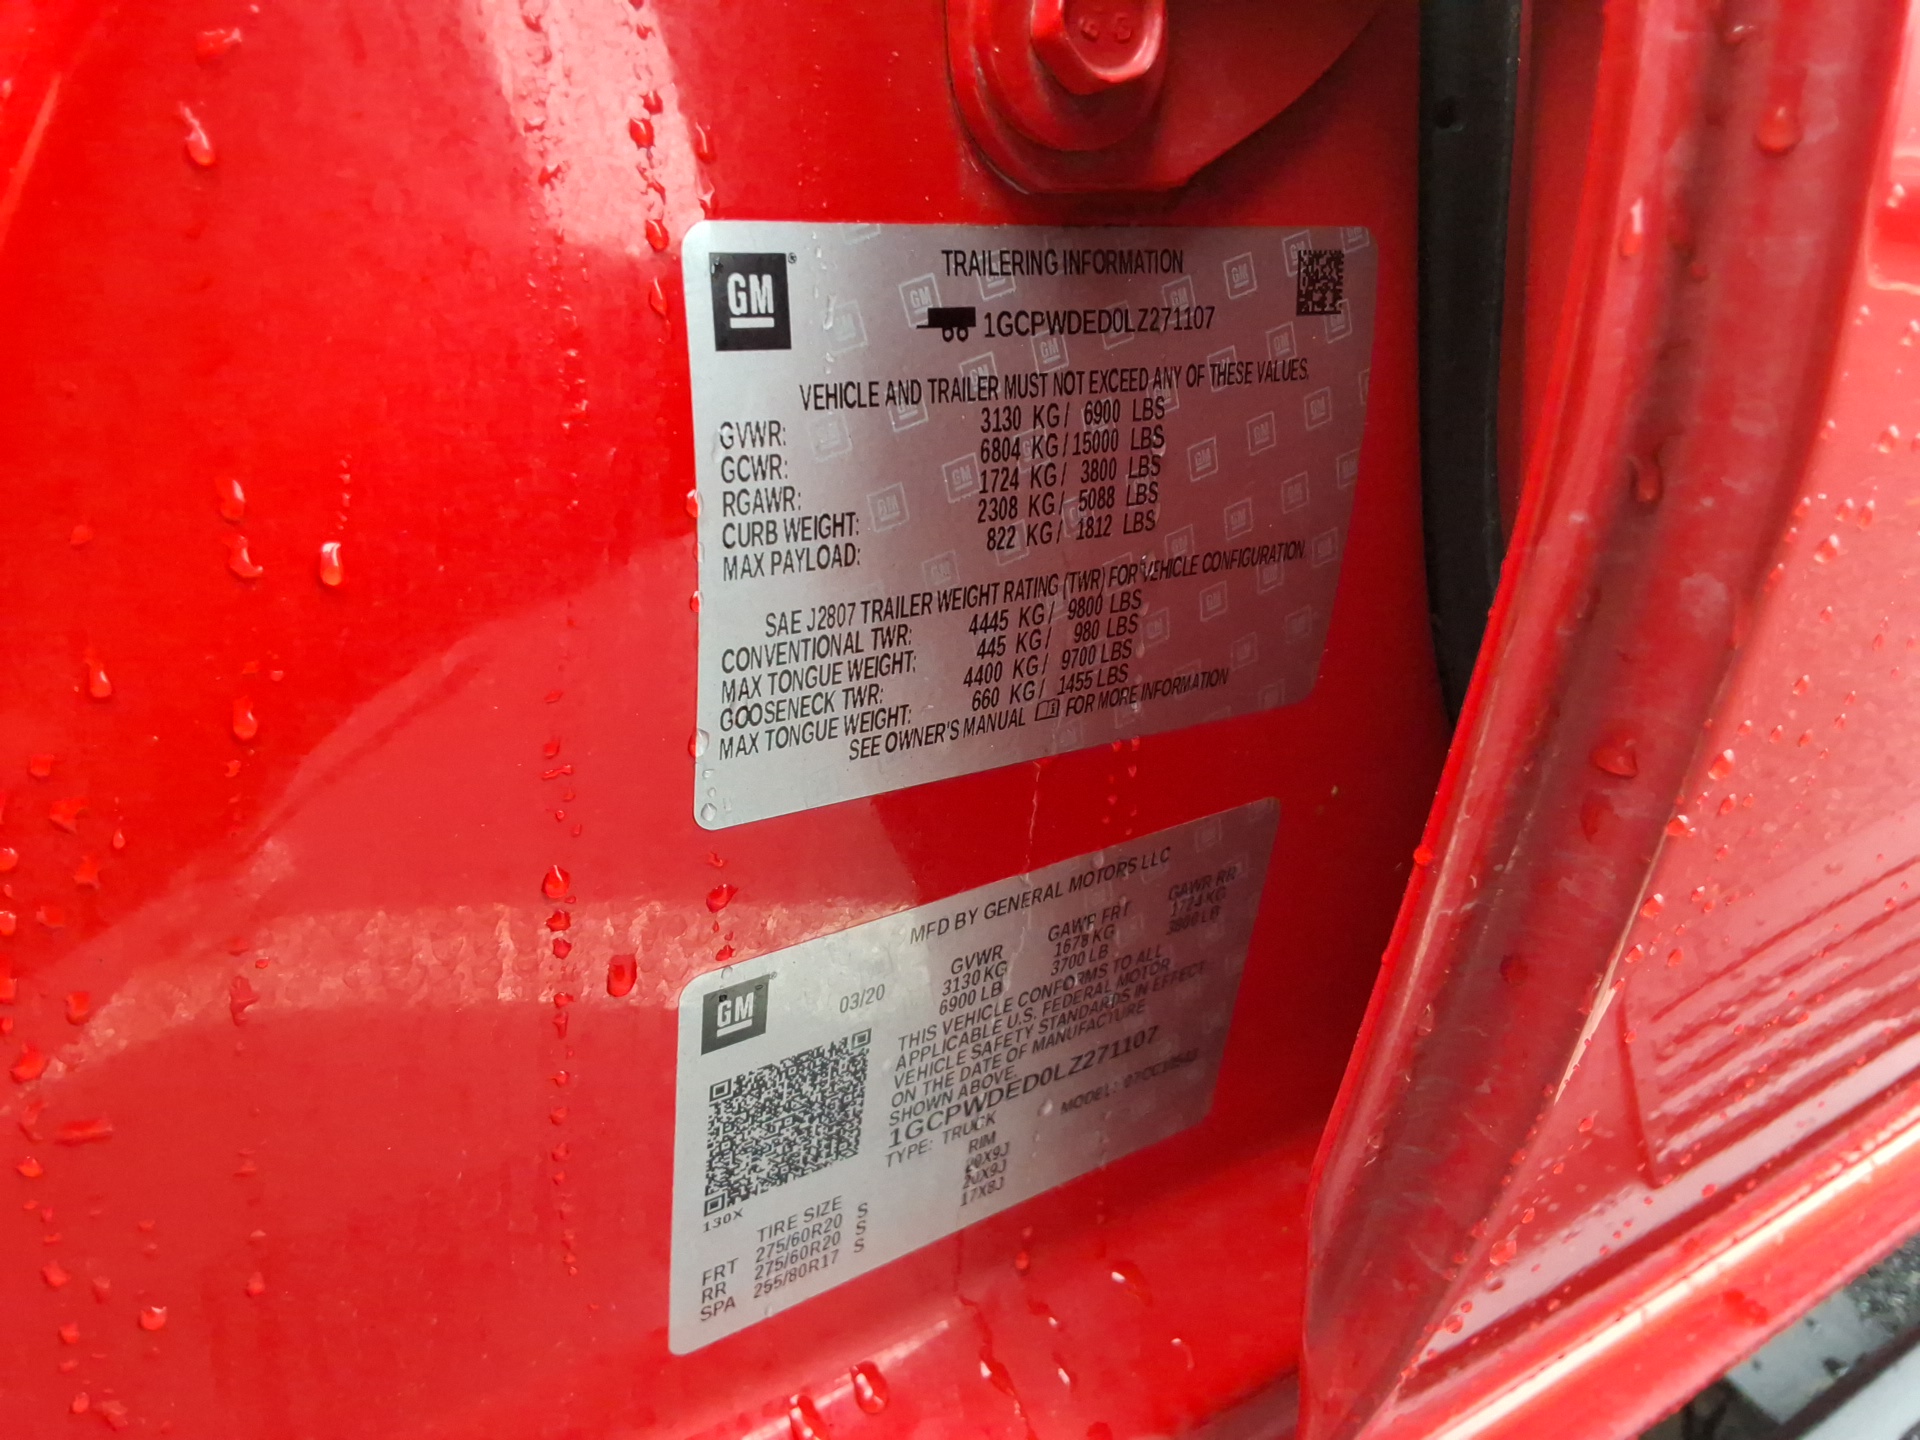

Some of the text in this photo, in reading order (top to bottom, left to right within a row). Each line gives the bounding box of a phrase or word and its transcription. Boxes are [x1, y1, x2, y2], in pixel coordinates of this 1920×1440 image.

[941, 248, 1184, 277] TRAILERING INFORMATION
[727, 272, 775, 316] GM
[799, 357, 1310, 411] VEHICLE AND TRAILER MUST NOT EXCEED ANY OF THESE VALUES.
[980, 407, 1021, 433] 3130
[1084, 399, 1121, 426] 6900
[1132, 395, 1166, 422] LBS
[719, 420, 787, 450] GVWR:
[980, 436, 1021, 464] 6804
[1072, 428, 1119, 456] 15000
[1130, 424, 1165, 452] LBS
[721, 453, 788, 484] GCWR:
[979, 466, 1020, 494] 1724
[1080, 458, 1117, 485] 3800
[1128, 453, 1162, 479] LBS
[722, 486, 801, 518] RGAWR:
[977, 496, 1018, 524] 2308
[1078, 486, 1115, 513] 5088
[1126, 482, 1159, 507] LBS
[721, 511, 860, 549] CURB WEIGHT:
[986, 524, 1016, 551] 822
[1075, 515, 1113, 541] 1812
[1123, 510, 1156, 534] LBS
[723, 542, 860, 582] MAX PAYLOAD:
[765, 609, 802, 639] SAE
[806, 603, 856, 632] J2807
[860, 592, 933, 624] TRAILER
[936, 581, 1001, 612] WEIGHT
[1003, 573, 1059, 603] RATING
[1062, 568, 1106, 598] (TWR)
[1107, 563, 1139, 588] FOR
[1141, 554, 1200, 583] VEHICLE
[968, 611, 1009, 636] 4445
[1067, 594, 1102, 620] 9800
[1109, 588, 1142, 614] LBS
[721, 623, 913, 674] CONVENTIONAL TWR:
[976, 635, 1006, 660] 445
[1073, 620, 1100, 643] 980
[1106, 613, 1139, 639] LBS
[721, 650, 917, 704] MAX TONGUE WEIGHT:
[963, 663, 1002, 688] 4400
[1061, 646, 1097, 670] 9700
[1100, 638, 1133, 664] LBS
[720, 683, 884, 732] GOOSENECK TWR:
[971, 687, 1000, 712] 660
[1056, 671, 1093, 697] 1455
[1096, 664, 1129, 688] LBS
[719, 704, 912, 762] MAX TONGUE WEIGHT:
[849, 668, 1229, 761] SEE OWNER'S MANUAL FOR MORE INFORMATION
[910, 846, 1171, 944] MFD BY GENERAL MOTORS LLC
[1168, 875, 1212, 900] GAWR
[1101, 901, 1132, 925] FRT
[951, 944, 1003, 975] GVWR
[1051, 944, 1108, 977] 3700 LB
[1053, 924, 1115, 958] 1678 KG
[898, 944, 1161, 1052] THIS VEHICLE CONFORMS TO ALL
[939, 980, 1003, 1016] 6900 LB
[942, 960, 1008, 996] 3130 KG
[716, 991, 754, 1028] GM
[839, 984, 885, 1014] 03/20
[894, 957, 1171, 1072] APPLICABLE U.S. FEDERAL MOTOR
[891, 999, 1146, 1108] ON THE DATE OF MANUFACTURE
[894, 1051, 966, 1090] VEHICLE
[971, 1024, 1034, 1061] SAFETY
[1038, 987, 1131, 1034] STANDARDS
[887, 1024, 1160, 1149] 1GCPWDED0LZ271107
[889, 1064, 1018, 1127] SHOWN ABOVE.
[885, 1110, 996, 1167] TYPE: TRUCK
[969, 1130, 996, 1153] RIM
[960, 1176, 1005, 1207] 17X8J
[703, 1207, 743, 1233] 130X
[755, 1202, 868, 1264] 275/60R20 S
[756, 1195, 843, 1243] TIRE SIZE
[753, 1237, 865, 1299] 255/80R17 S
[754, 1219, 867, 1281] 275/60R20 S
[702, 1257, 740, 1287] FRT
[700, 1295, 736, 1322] SPA
[702, 1282, 727, 1304] RR
